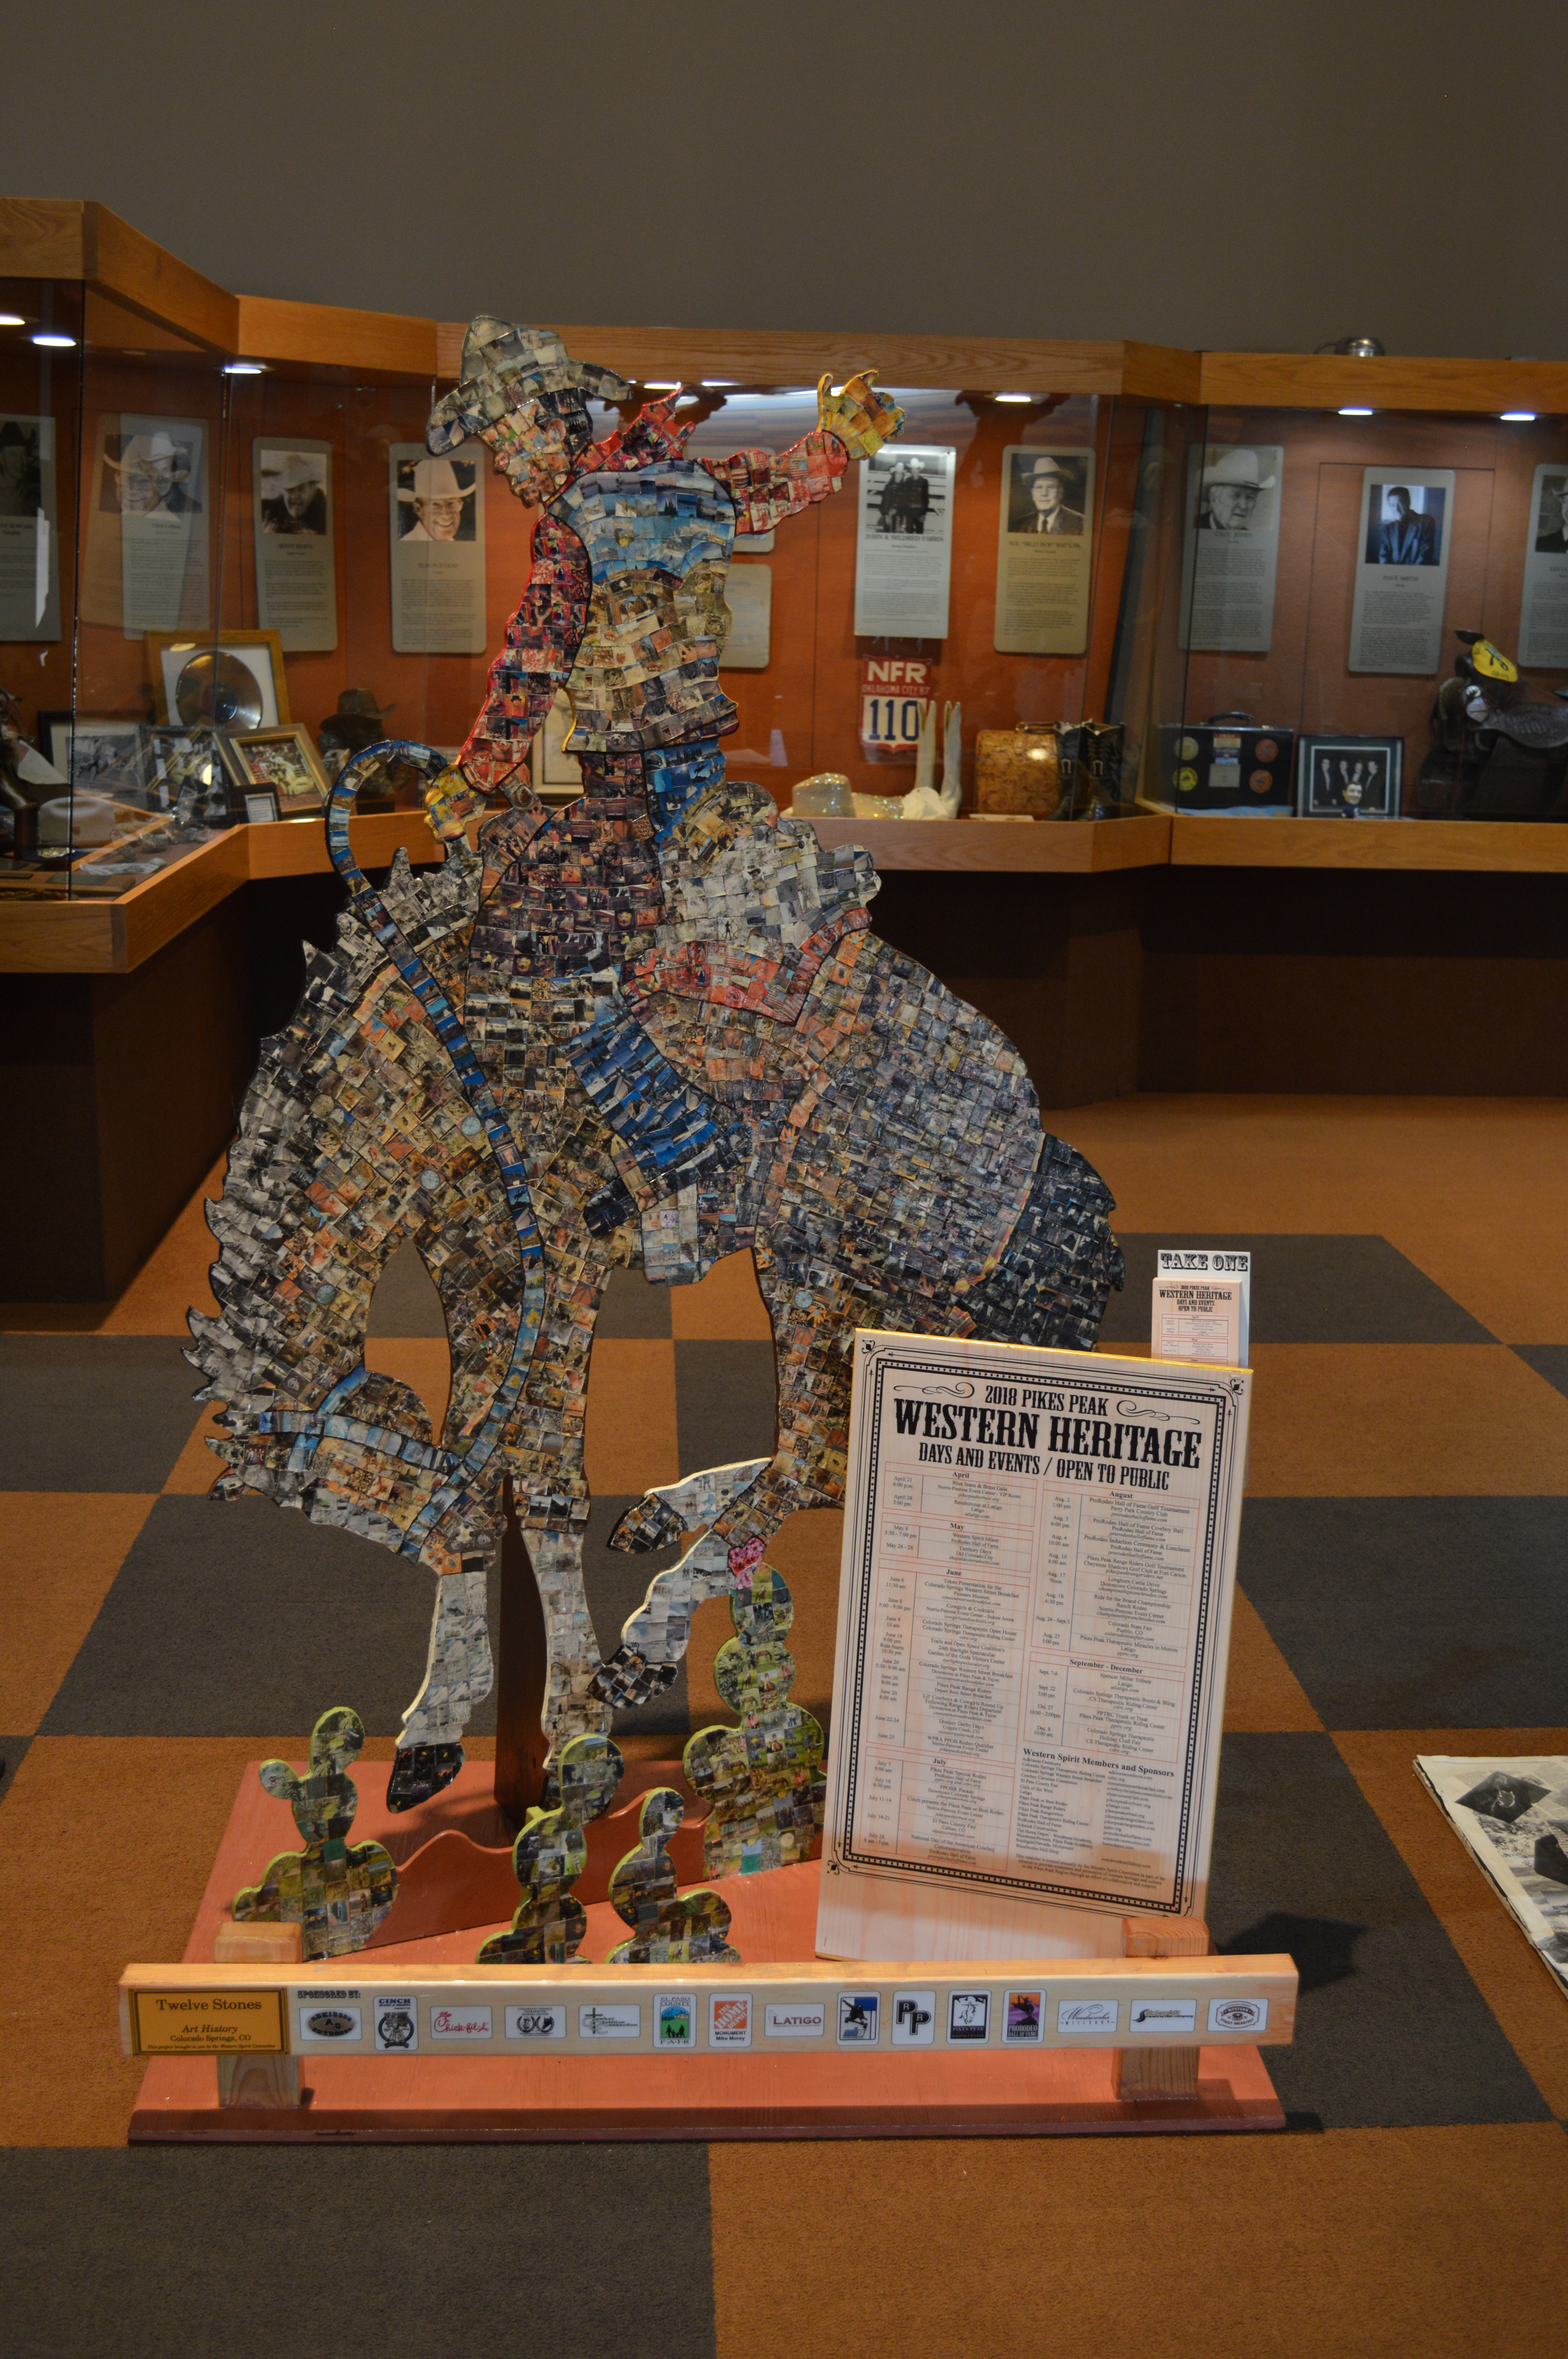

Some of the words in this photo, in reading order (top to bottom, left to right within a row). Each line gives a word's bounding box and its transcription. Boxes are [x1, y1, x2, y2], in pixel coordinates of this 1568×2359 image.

[867, 661, 927, 683] NFR
[862, 685, 900, 693] OKLAHOMA
[902, 686, 918, 694] CITY
[869, 699, 919, 741] 110
[1161, 1253, 1208, 1270] TAKE
[1212, 1254, 1248, 1272] ONE
[1159, 1289, 1194, 1299] WESTERN
[1196, 1291, 1232, 1300] HERITAGE
[985, 1385, 1018, 1406] 2018
[1021, 1389, 1065, 1412] PIKES
[1068, 1394, 1109, 1417] PEAK
[894, 1398, 1040, 1449] WESTERN
[1047, 1416, 1202, 1469] HERITAGE
[918, 1442, 953, 1465] DAYS
[955, 1447, 984, 1468] AND
[988, 1450, 1040, 1475] EVENTS
[1043, 1457, 1053, 1476] /
[1056, 1459, 1094, 1481] OPEN
[1097, 1463, 1116, 1484] TO
[1120, 1466, 1170, 1490] PUBLIC
[1110, 1491, 1133, 1499] August
[1160, 1505, 1190, 1514] Tournament
[1069, 1659, 1105, 1669] September
[1110, 1664, 1143, 1674] December
[933, 1758, 946, 1767] July
[1024, 1748, 1055, 1759] Western
[1058, 1754, 1080, 1763] Spirit
[1082, 1757, 1119, 1769] Members
[1138, 1766, 1174, 1777] Sponsors
[298, 1990, 347, 1999] SPONSORED
[348, 1990, 361, 1999] BY:
[156, 1999, 209, 2010] Twelve
[213, 1998, 262, 2010] Stones
[718, 2003, 732, 2015] THE
[310, 2011, 352, 2022] ADKISSON
[714, 2000, 748, 2029] HOME
[1061, 2004, 1110, 2020] Woodworks
[434, 2012, 488, 2033] Chick-fil-A
[728, 2013, 748, 2029] DEPOT
[773, 2016, 821, 2025] LATIGO
[181, 2025, 199, 2033] Art
[201, 2024, 238, 2034] History
[312, 2027, 352, 2036] OUTDOORS
[206, 2034, 237, 2043] Springs,
